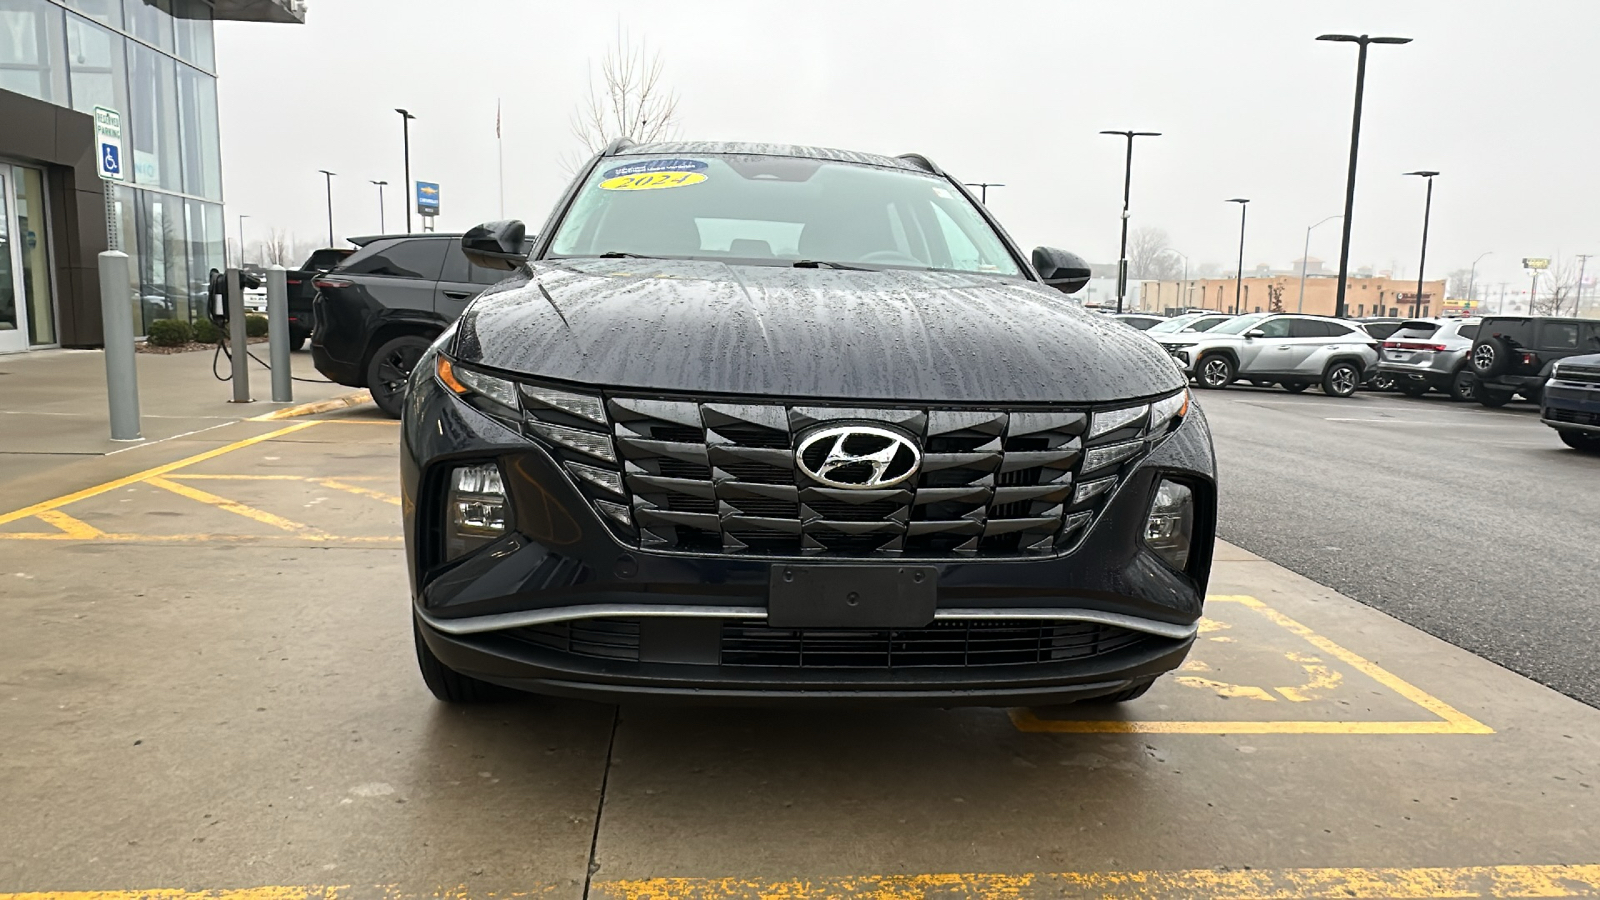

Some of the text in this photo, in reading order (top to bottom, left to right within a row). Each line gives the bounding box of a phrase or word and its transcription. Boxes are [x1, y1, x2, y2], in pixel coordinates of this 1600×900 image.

[97, 113, 119, 127] RESERVED
[97, 125, 120, 139] PARKING
[616, 174, 692, 188] 2024
